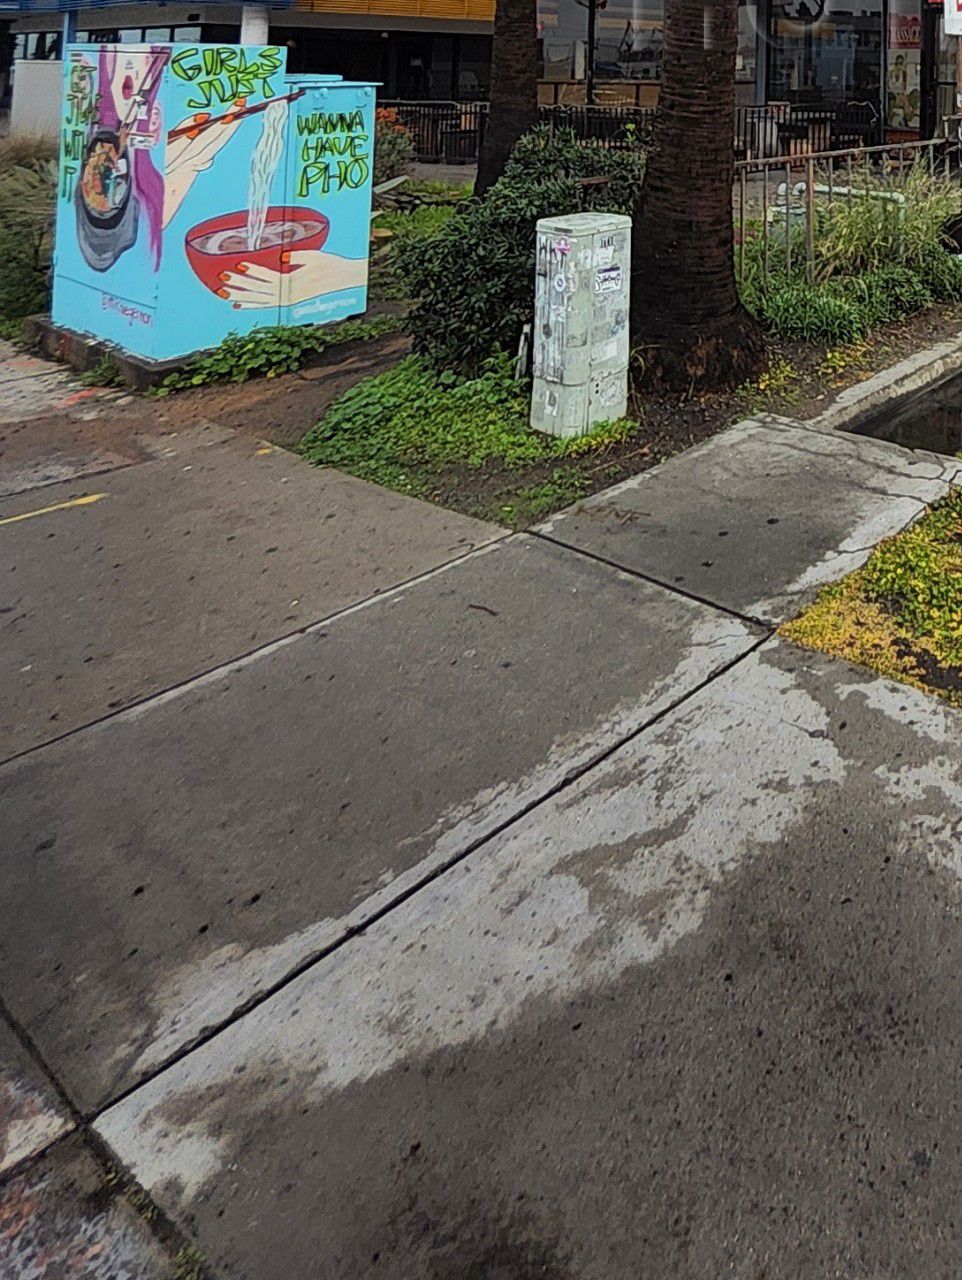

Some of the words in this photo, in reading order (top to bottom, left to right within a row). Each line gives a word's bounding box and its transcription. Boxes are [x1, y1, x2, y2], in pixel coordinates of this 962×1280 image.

[172, 47, 283, 78] GIRLS
[188, 70, 279, 108] JUST
[297, 110, 365, 137] WANNA
[302, 134, 369, 163] HAVE
[298, 156, 369, 198] PHO
